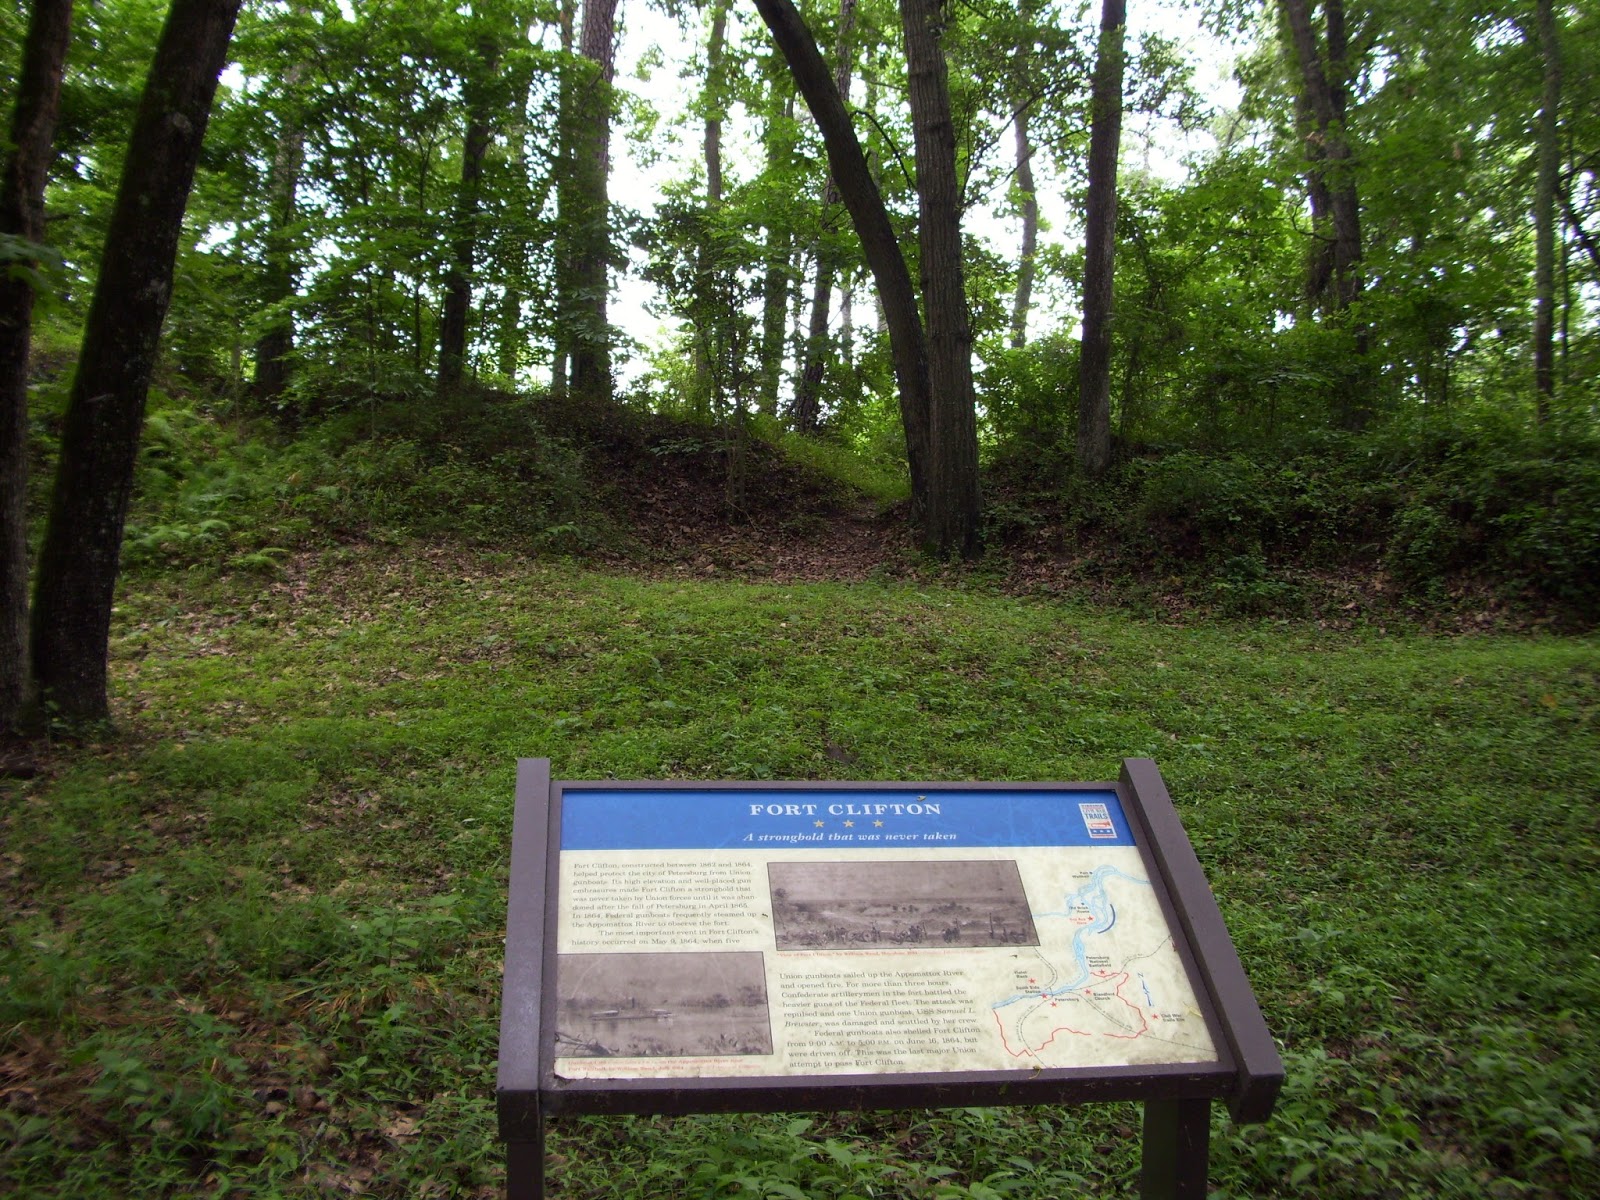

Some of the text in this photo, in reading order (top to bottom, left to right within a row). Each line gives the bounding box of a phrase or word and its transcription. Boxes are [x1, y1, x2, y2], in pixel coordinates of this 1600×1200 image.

[749, 803, 941, 816] FORT CLIFTON
[743, 833, 754, 841] A
[758, 832, 824, 843] stronghold
[828, 833, 854, 841] that
[923, 831, 957, 840] taken
[694, 886, 734, 894] stronghold
[586, 921, 633, 929] Appomattox
[805, 972, 841, 980] gunboats
[894, 971, 941, 979] Appomattox
[797, 982, 825, 990] opened
[831, 990, 880, 998] artillerymen
[783, 1011, 817, 1019] repulsed
[841, 1019, 878, 1027] damaged
[846, 1029, 883, 1037] gunboats
[789, 1061, 822, 1069] attempt
